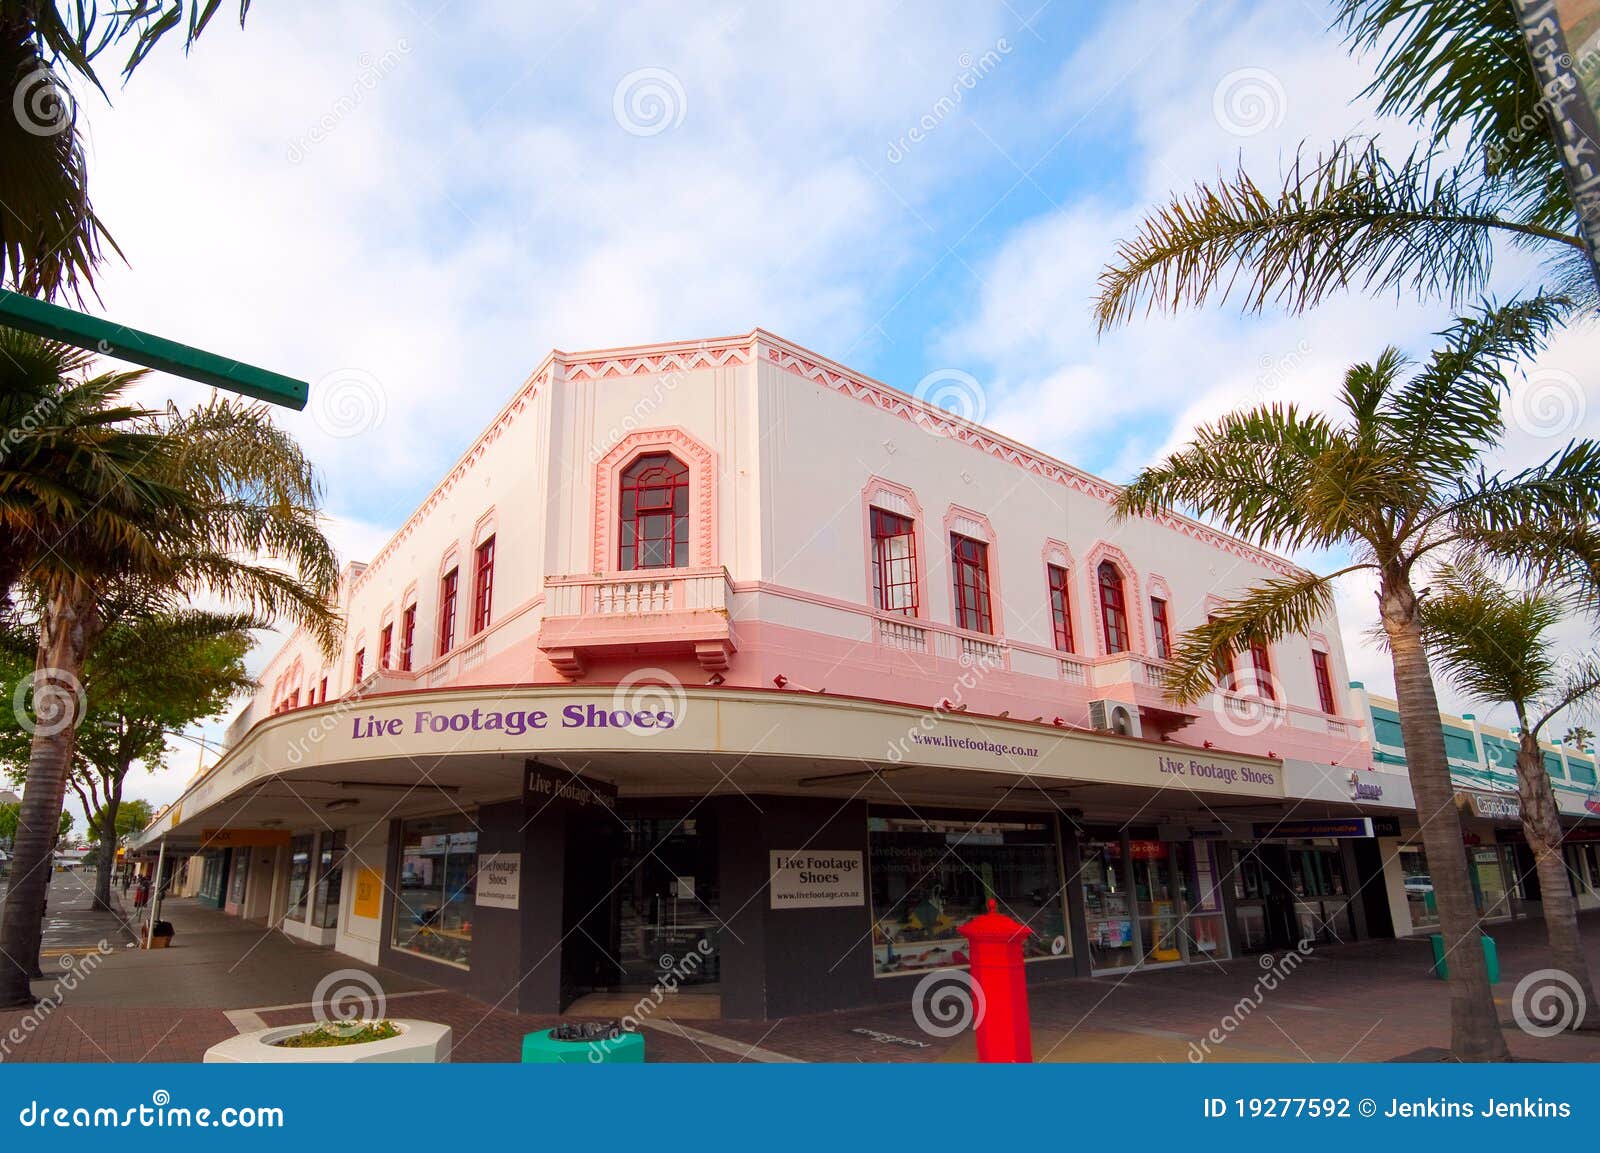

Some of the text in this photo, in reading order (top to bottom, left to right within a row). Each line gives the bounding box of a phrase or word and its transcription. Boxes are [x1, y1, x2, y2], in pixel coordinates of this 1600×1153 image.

[352, 704, 675, 739] Live Footage Shoes
[913, 734, 1039, 757] www.livefootage.co.nz
[1159, 756, 1274, 785] Live Footage Shoes
[528, 772, 552, 794] Live
[555, 778, 591, 806] Footage
[777, 857, 804, 869] Live
[807, 857, 858, 872] Footage
[800, 872, 839, 884] Shoes
[777, 891, 859, 900] www.livefootage.co.nz
